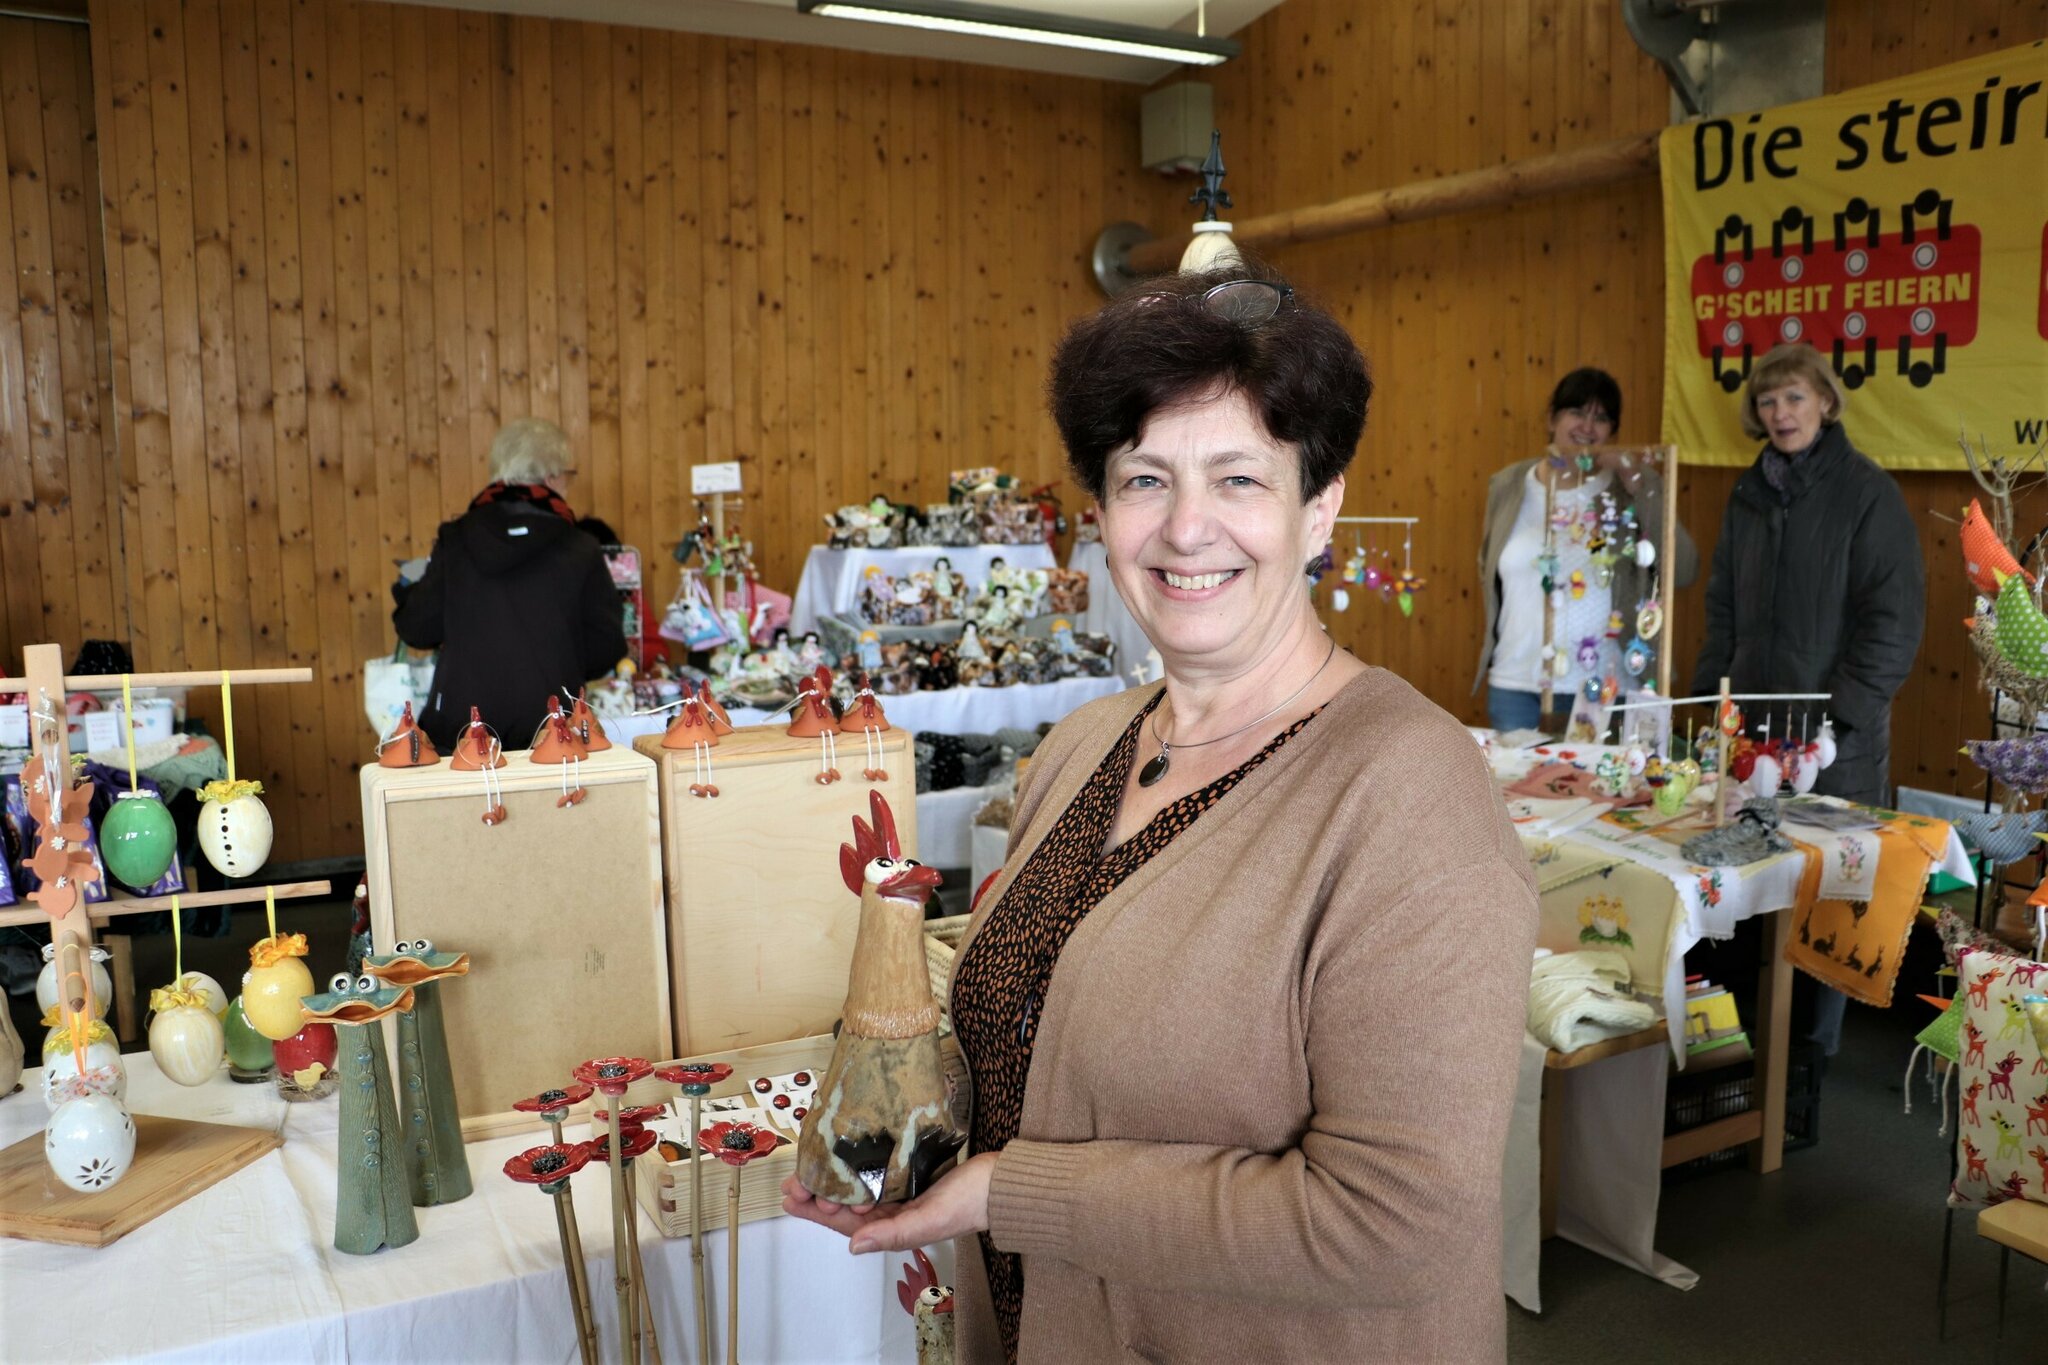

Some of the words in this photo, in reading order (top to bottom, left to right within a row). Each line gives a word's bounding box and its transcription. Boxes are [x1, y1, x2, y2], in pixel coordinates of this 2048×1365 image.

[1693, 113, 1803, 191] Die
[1835, 76, 2048, 171] steir
[1694, 284, 1833, 321] G'SCHEIT
[1844, 272, 1972, 310] FEIERN
